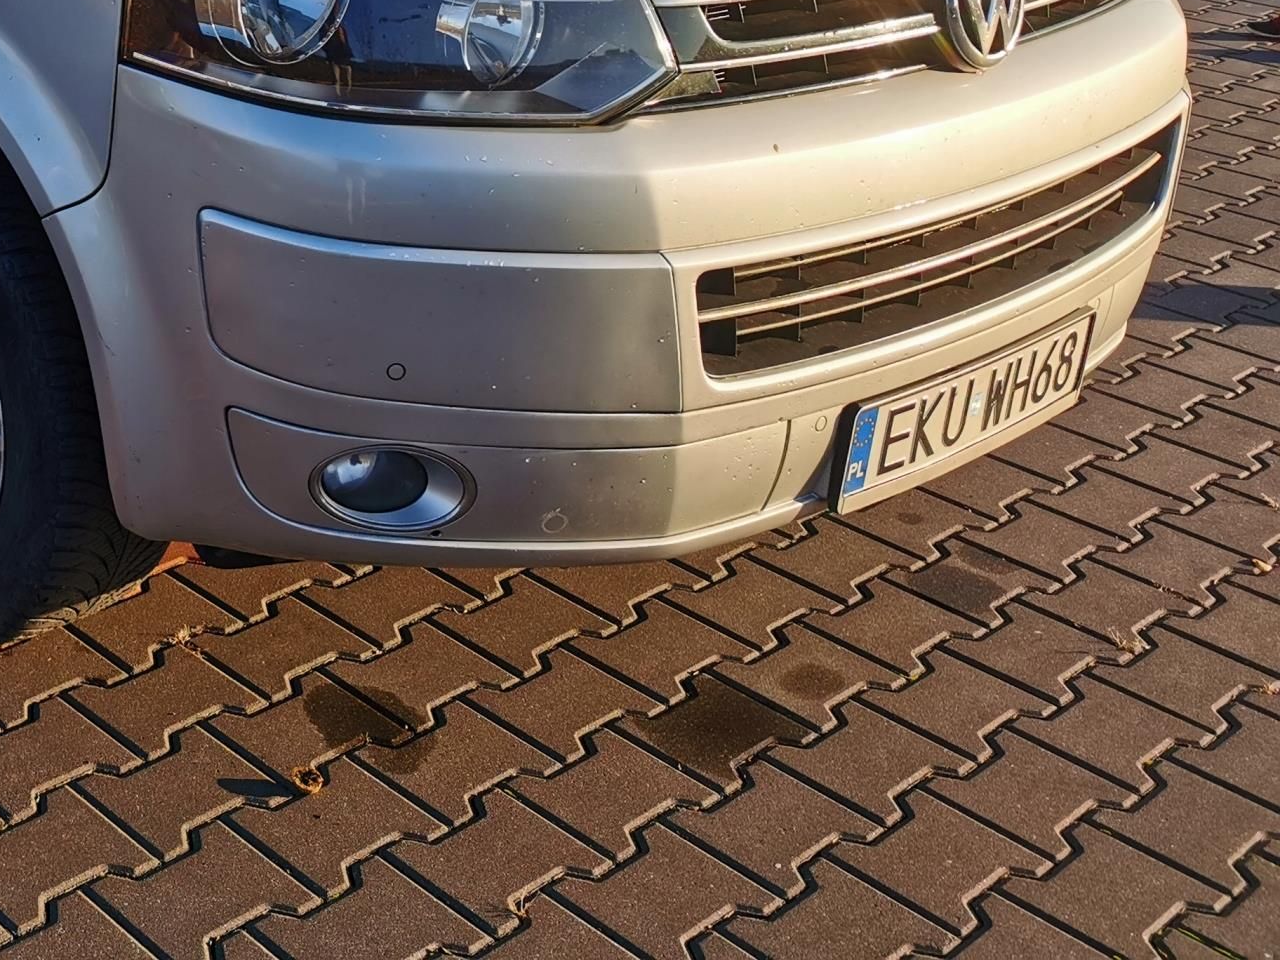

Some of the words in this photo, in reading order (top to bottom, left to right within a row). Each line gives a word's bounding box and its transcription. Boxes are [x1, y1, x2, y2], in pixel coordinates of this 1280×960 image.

[877, 378, 975, 475] EKU
[981, 331, 1078, 432] WH68
[846, 463, 864, 482] PL
